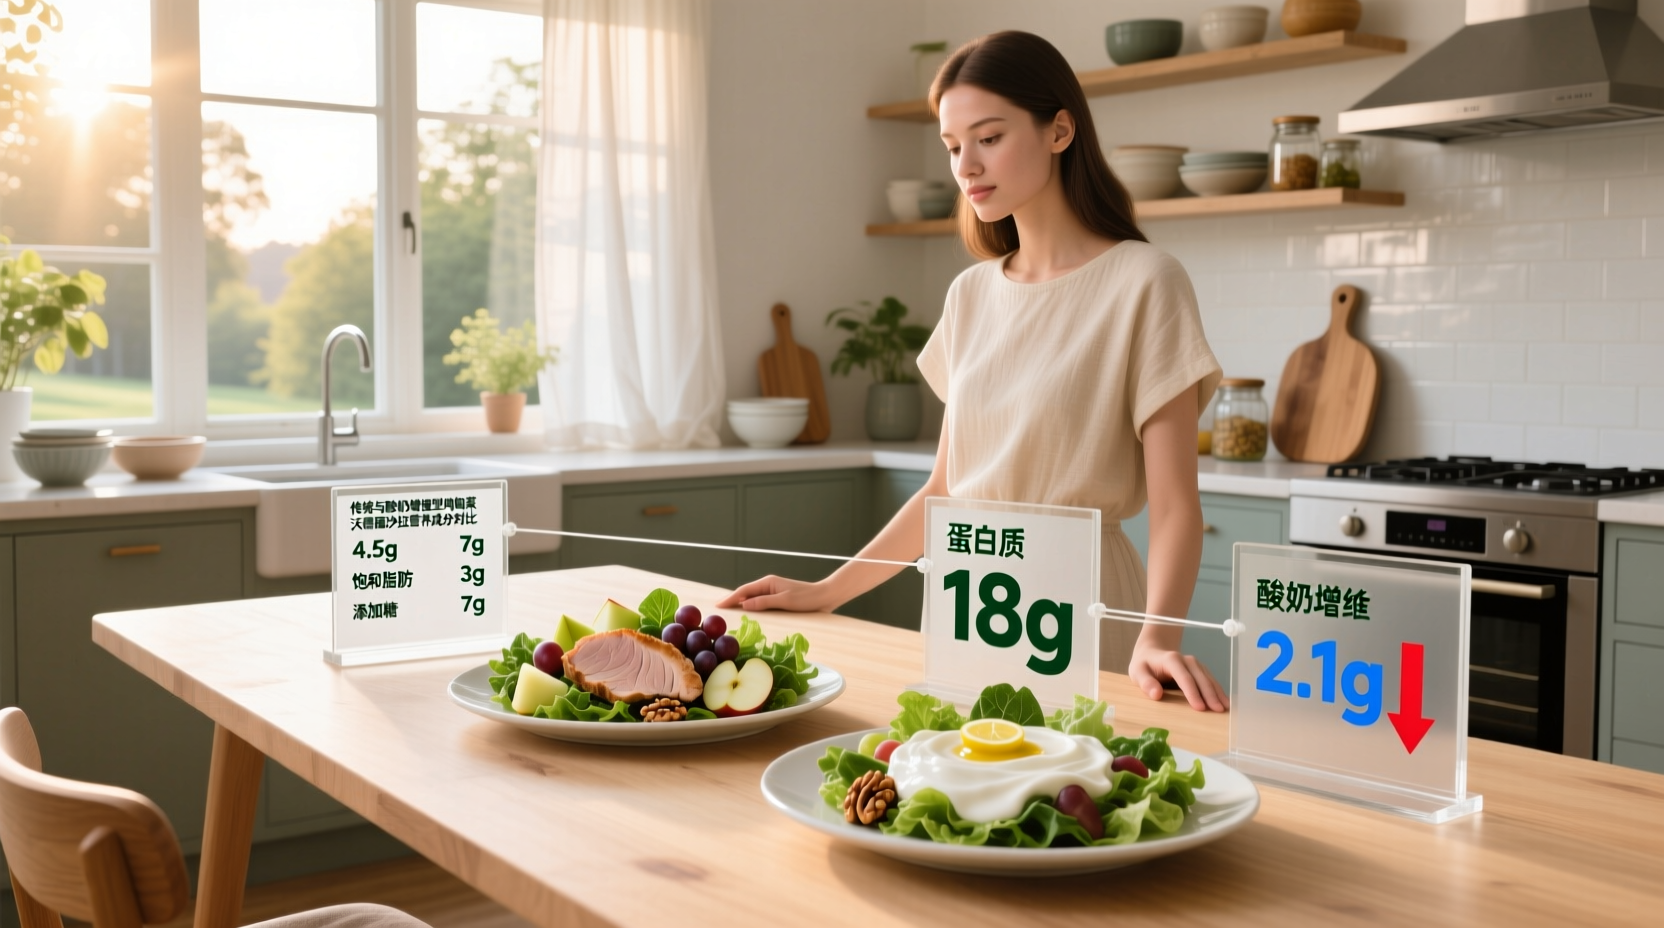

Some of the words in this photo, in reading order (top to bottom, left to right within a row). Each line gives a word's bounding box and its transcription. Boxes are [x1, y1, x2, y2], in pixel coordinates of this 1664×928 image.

[352, 539, 398, 563] 4.5g
[459, 534, 484, 557] 7g
[947, 522, 1025, 560] 蛋白质
[460, 564, 485, 587] 3g
[352, 601, 399, 621] 添加糖
[460, 595, 486, 617] 7g
[1256, 578, 1371, 621] 酸奶增维
[943, 569, 1074, 676] 18g
[1255, 629, 1384, 727] 2.1g
